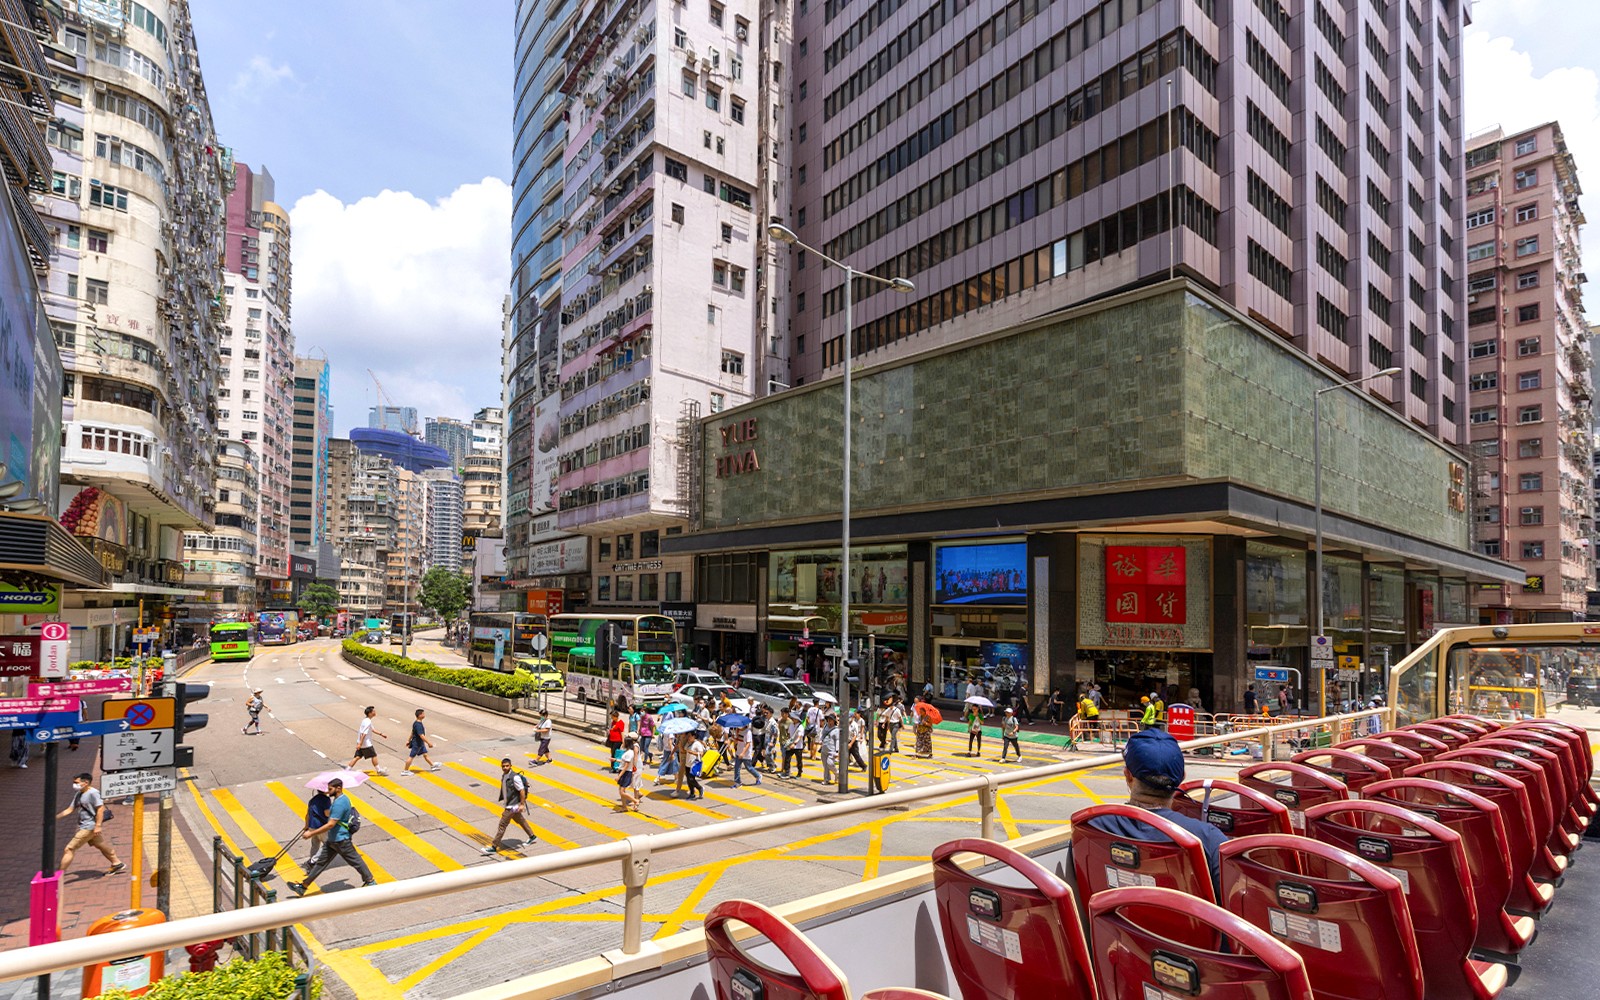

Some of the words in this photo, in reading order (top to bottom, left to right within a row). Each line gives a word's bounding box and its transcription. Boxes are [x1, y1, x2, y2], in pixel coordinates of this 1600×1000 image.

[719, 417, 758, 448] YUE
[716, 449, 760, 479] HWA
[1105, 626, 1137, 639] YUE
[1143, 627, 1184, 640] HWA
[48, 645, 60, 672] Jordan
[116, 738, 138, 747] 上午
[150, 731, 162, 744] 7
[116, 758, 137, 766] 下午
[150, 751, 162, 763] 7
[119, 771, 144, 780] Except
[109, 780, 125, 788] pick
[127, 777, 156, 786] up/drop
